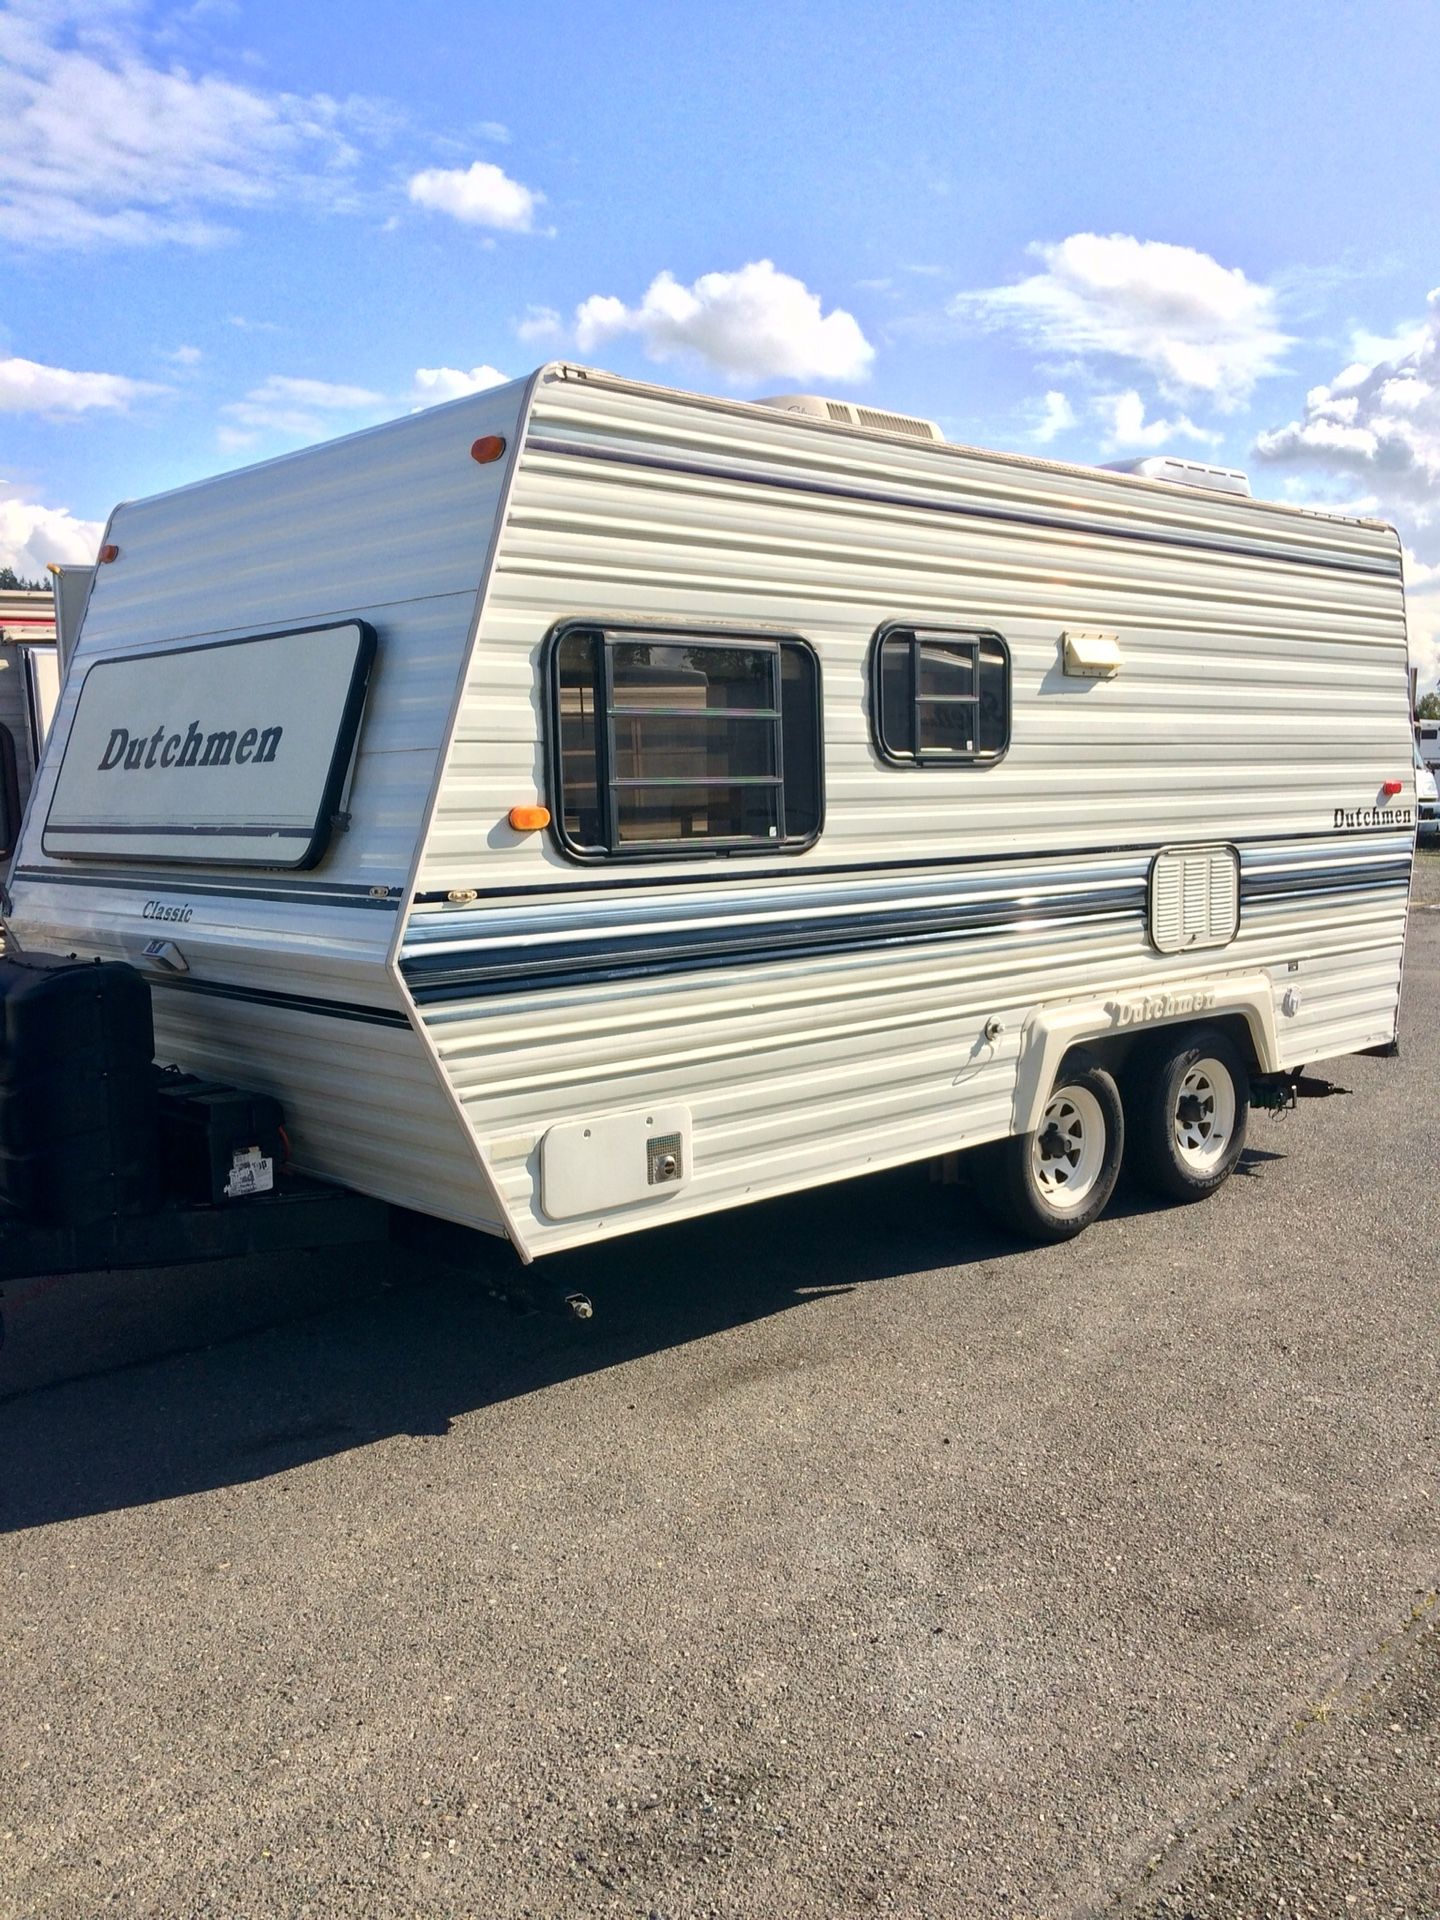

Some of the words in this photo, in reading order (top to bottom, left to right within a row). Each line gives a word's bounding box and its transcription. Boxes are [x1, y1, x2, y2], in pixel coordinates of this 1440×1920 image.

[97, 720, 284, 771] Dutchmen
[1333, 806, 1411, 829] Dutchmen
[142, 900, 194, 923] Classic
[1116, 992, 1217, 1027] Dutchmen
